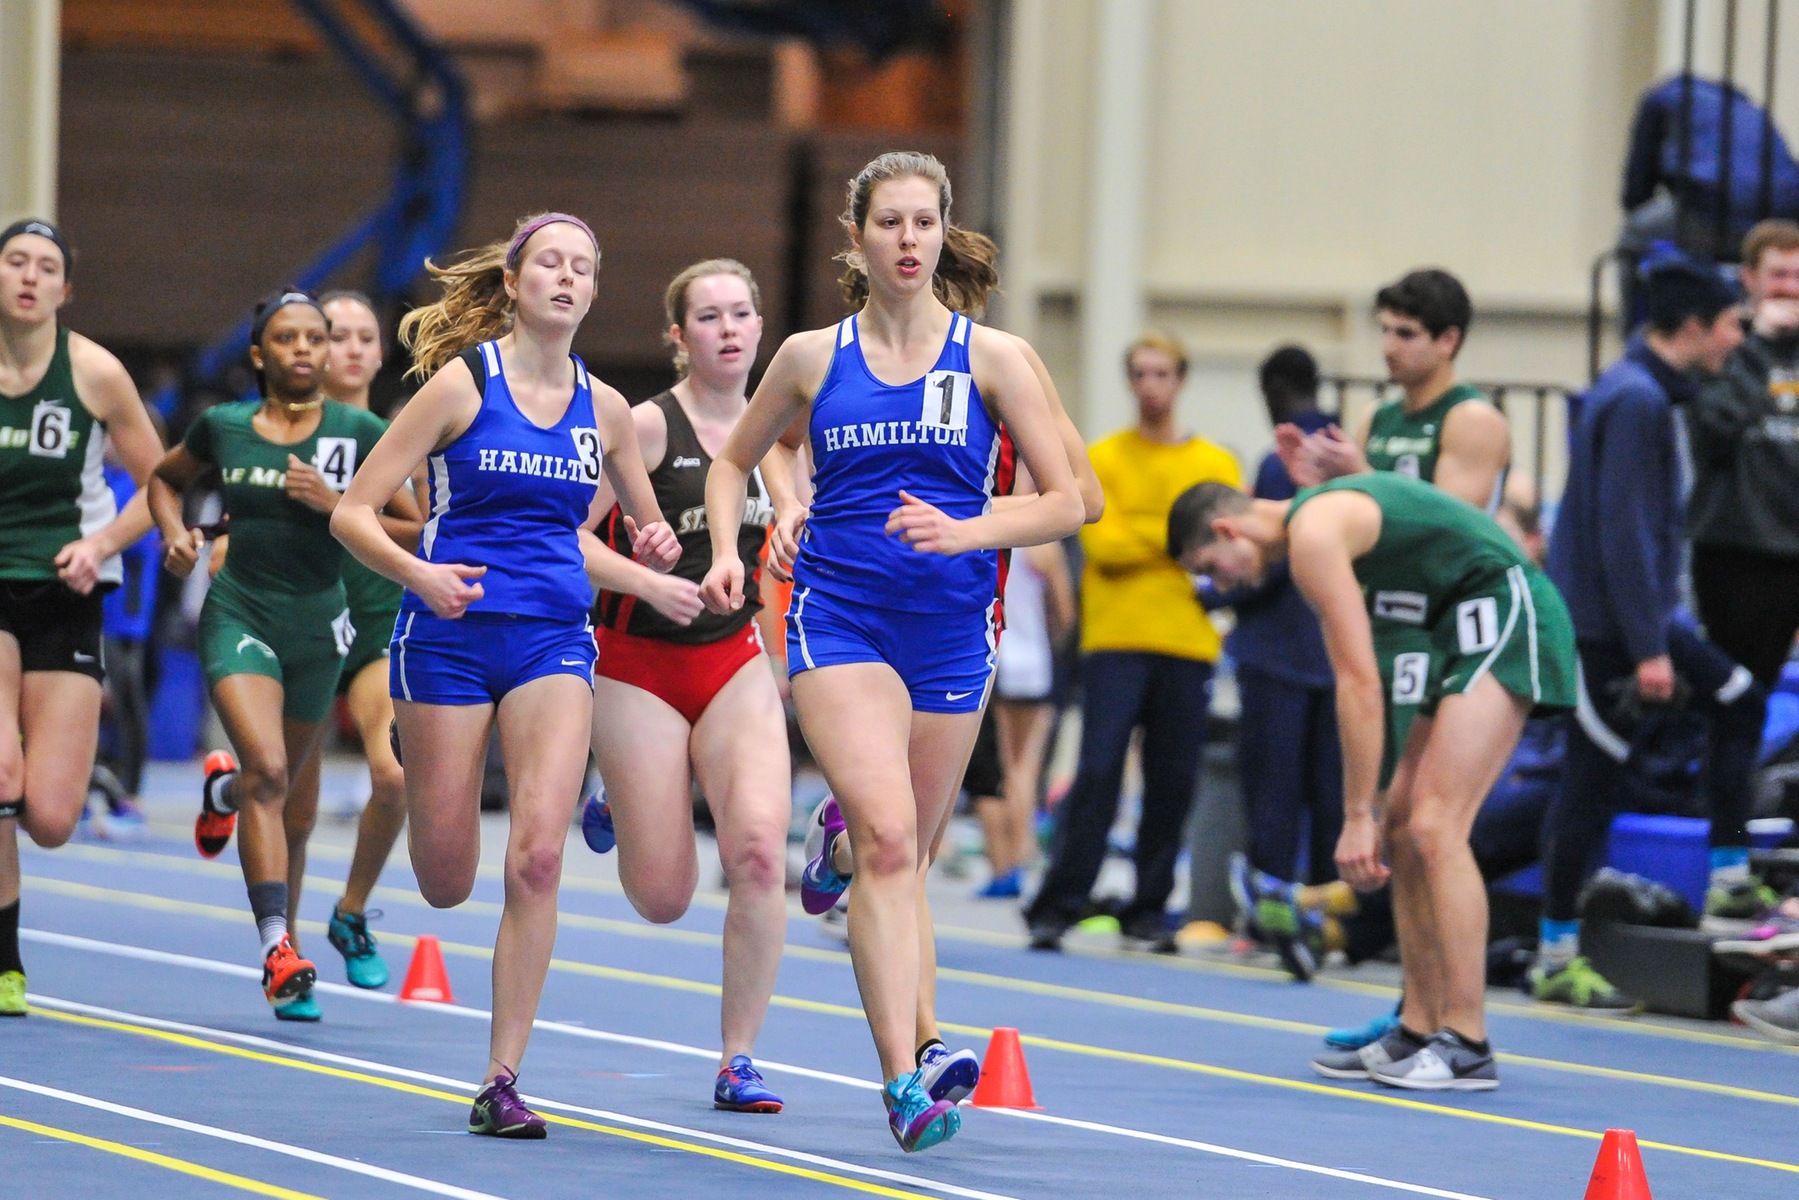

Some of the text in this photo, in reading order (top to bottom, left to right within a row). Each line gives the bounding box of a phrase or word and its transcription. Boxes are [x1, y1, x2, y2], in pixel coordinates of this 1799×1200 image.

[934, 374, 955, 425] 1
[37, 412, 63, 451] 6
[823, 421, 968, 452] HAMILTON
[323, 441, 347, 484] 4
[478, 449, 582, 482] HAMILT
[579, 432, 600, 480] 3
[1467, 605, 1482, 645] 1
[1400, 657, 1418, 695] 5
